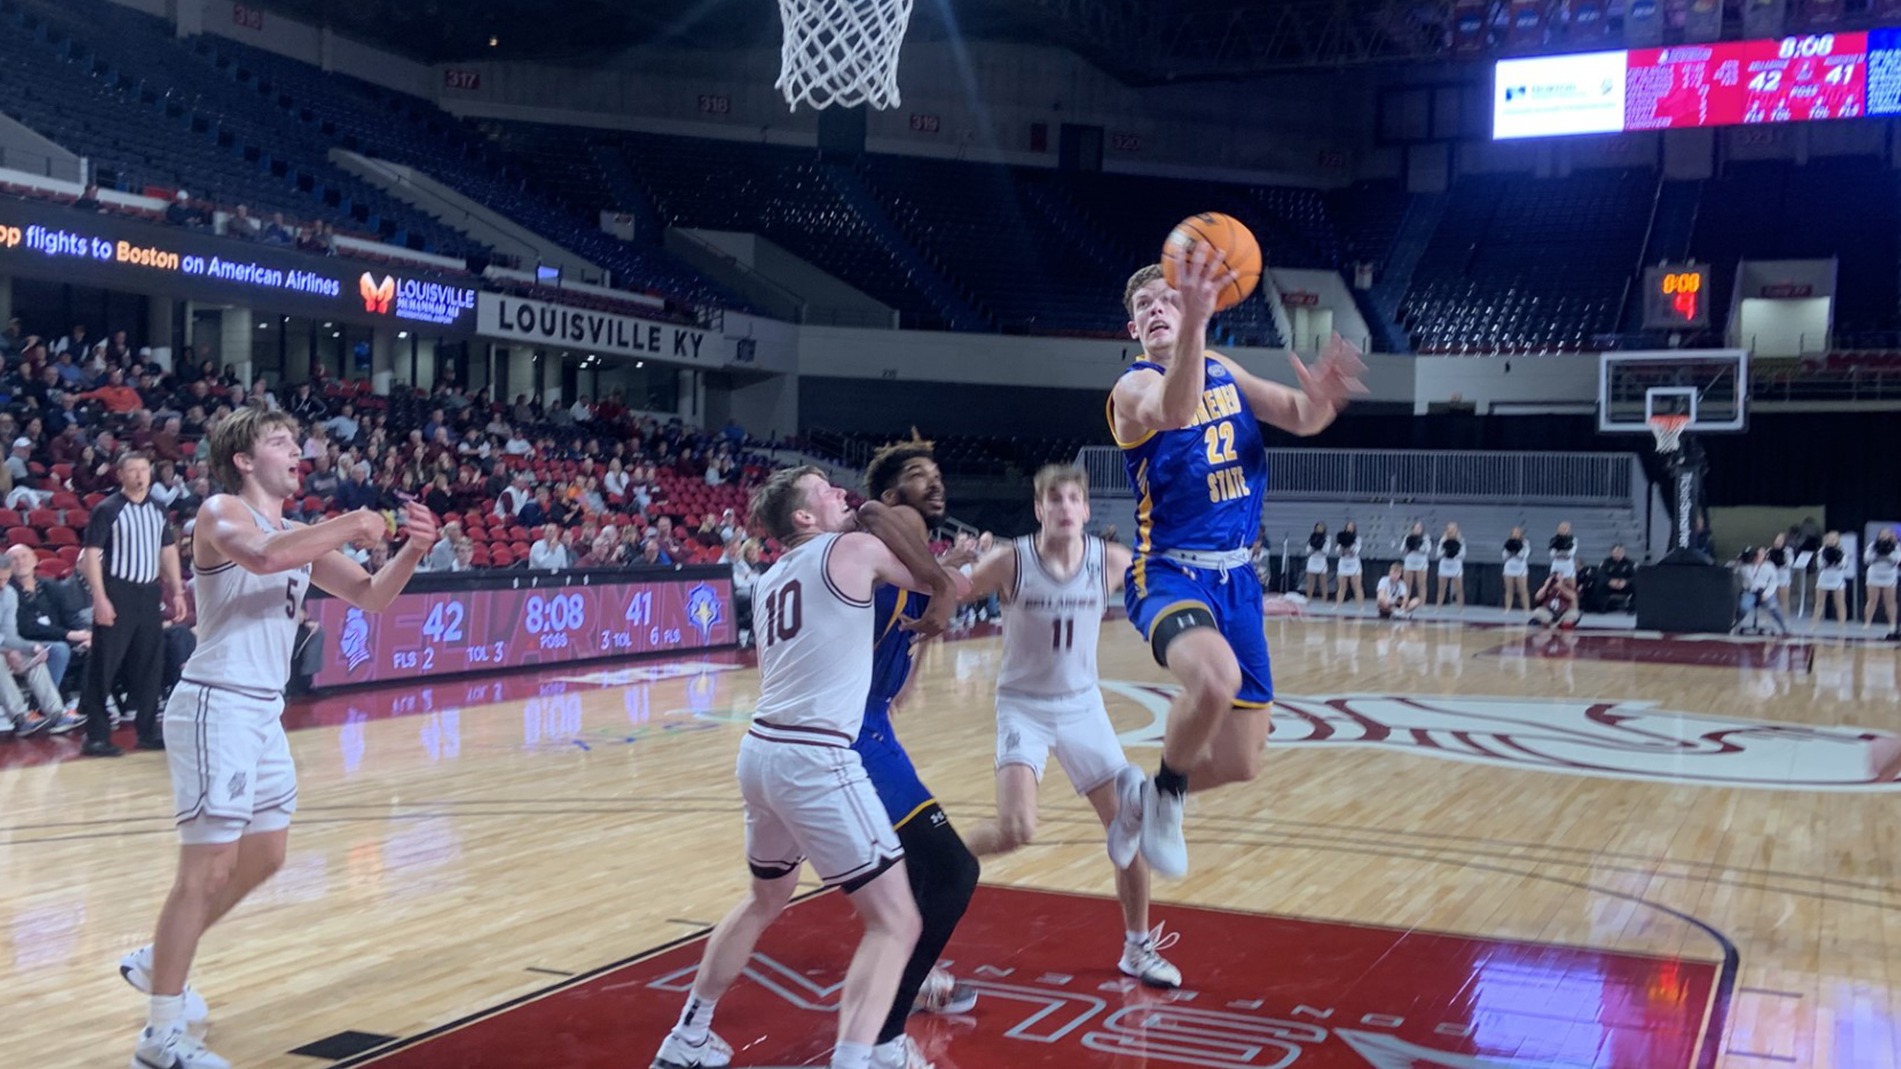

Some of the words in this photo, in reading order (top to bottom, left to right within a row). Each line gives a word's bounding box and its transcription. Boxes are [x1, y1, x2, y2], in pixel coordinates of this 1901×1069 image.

[1779, 34, 1834, 58] 8:08
[448, 71, 476, 87] 317
[1748, 70, 1782, 92] 42
[1825, 64, 1854, 85] 41
[700, 96, 728, 113] 318
[911, 116, 938, 131] 319
[26, 225, 88, 255] flights
[92, 236, 112, 259] to
[116, 240, 178, 270] Boston
[182, 255, 204, 274] on
[208, 256, 282, 287] American
[285, 270, 340, 296] Airlines
[396, 277, 475, 308] LOUISVILLE
[499, 300, 661, 351] LOUISVILLE
[674, 329, 704, 358] KY
[1204, 421, 1238, 464] 22
[1207, 466, 1250, 503] STATE
[285, 577, 298, 619] 5
[525, 592, 585, 634] 8:08
[625, 591, 652, 626] 41
[765, 578, 802, 647] 10
[423, 601, 464, 642] 42
[601, 630, 610, 650] 3
[613, 632, 632, 648] TOL
[650, 626, 659, 646] 6
[664, 628, 681, 644] FLS
[1052, 617, 1074, 651] 11
[393, 650, 417, 669] FLS
[422, 647, 434, 670] 2
[467, 646, 489, 663] TOL
[493, 641, 504, 663] 3
[938, 959, 1478, 1037] CONFEREN
